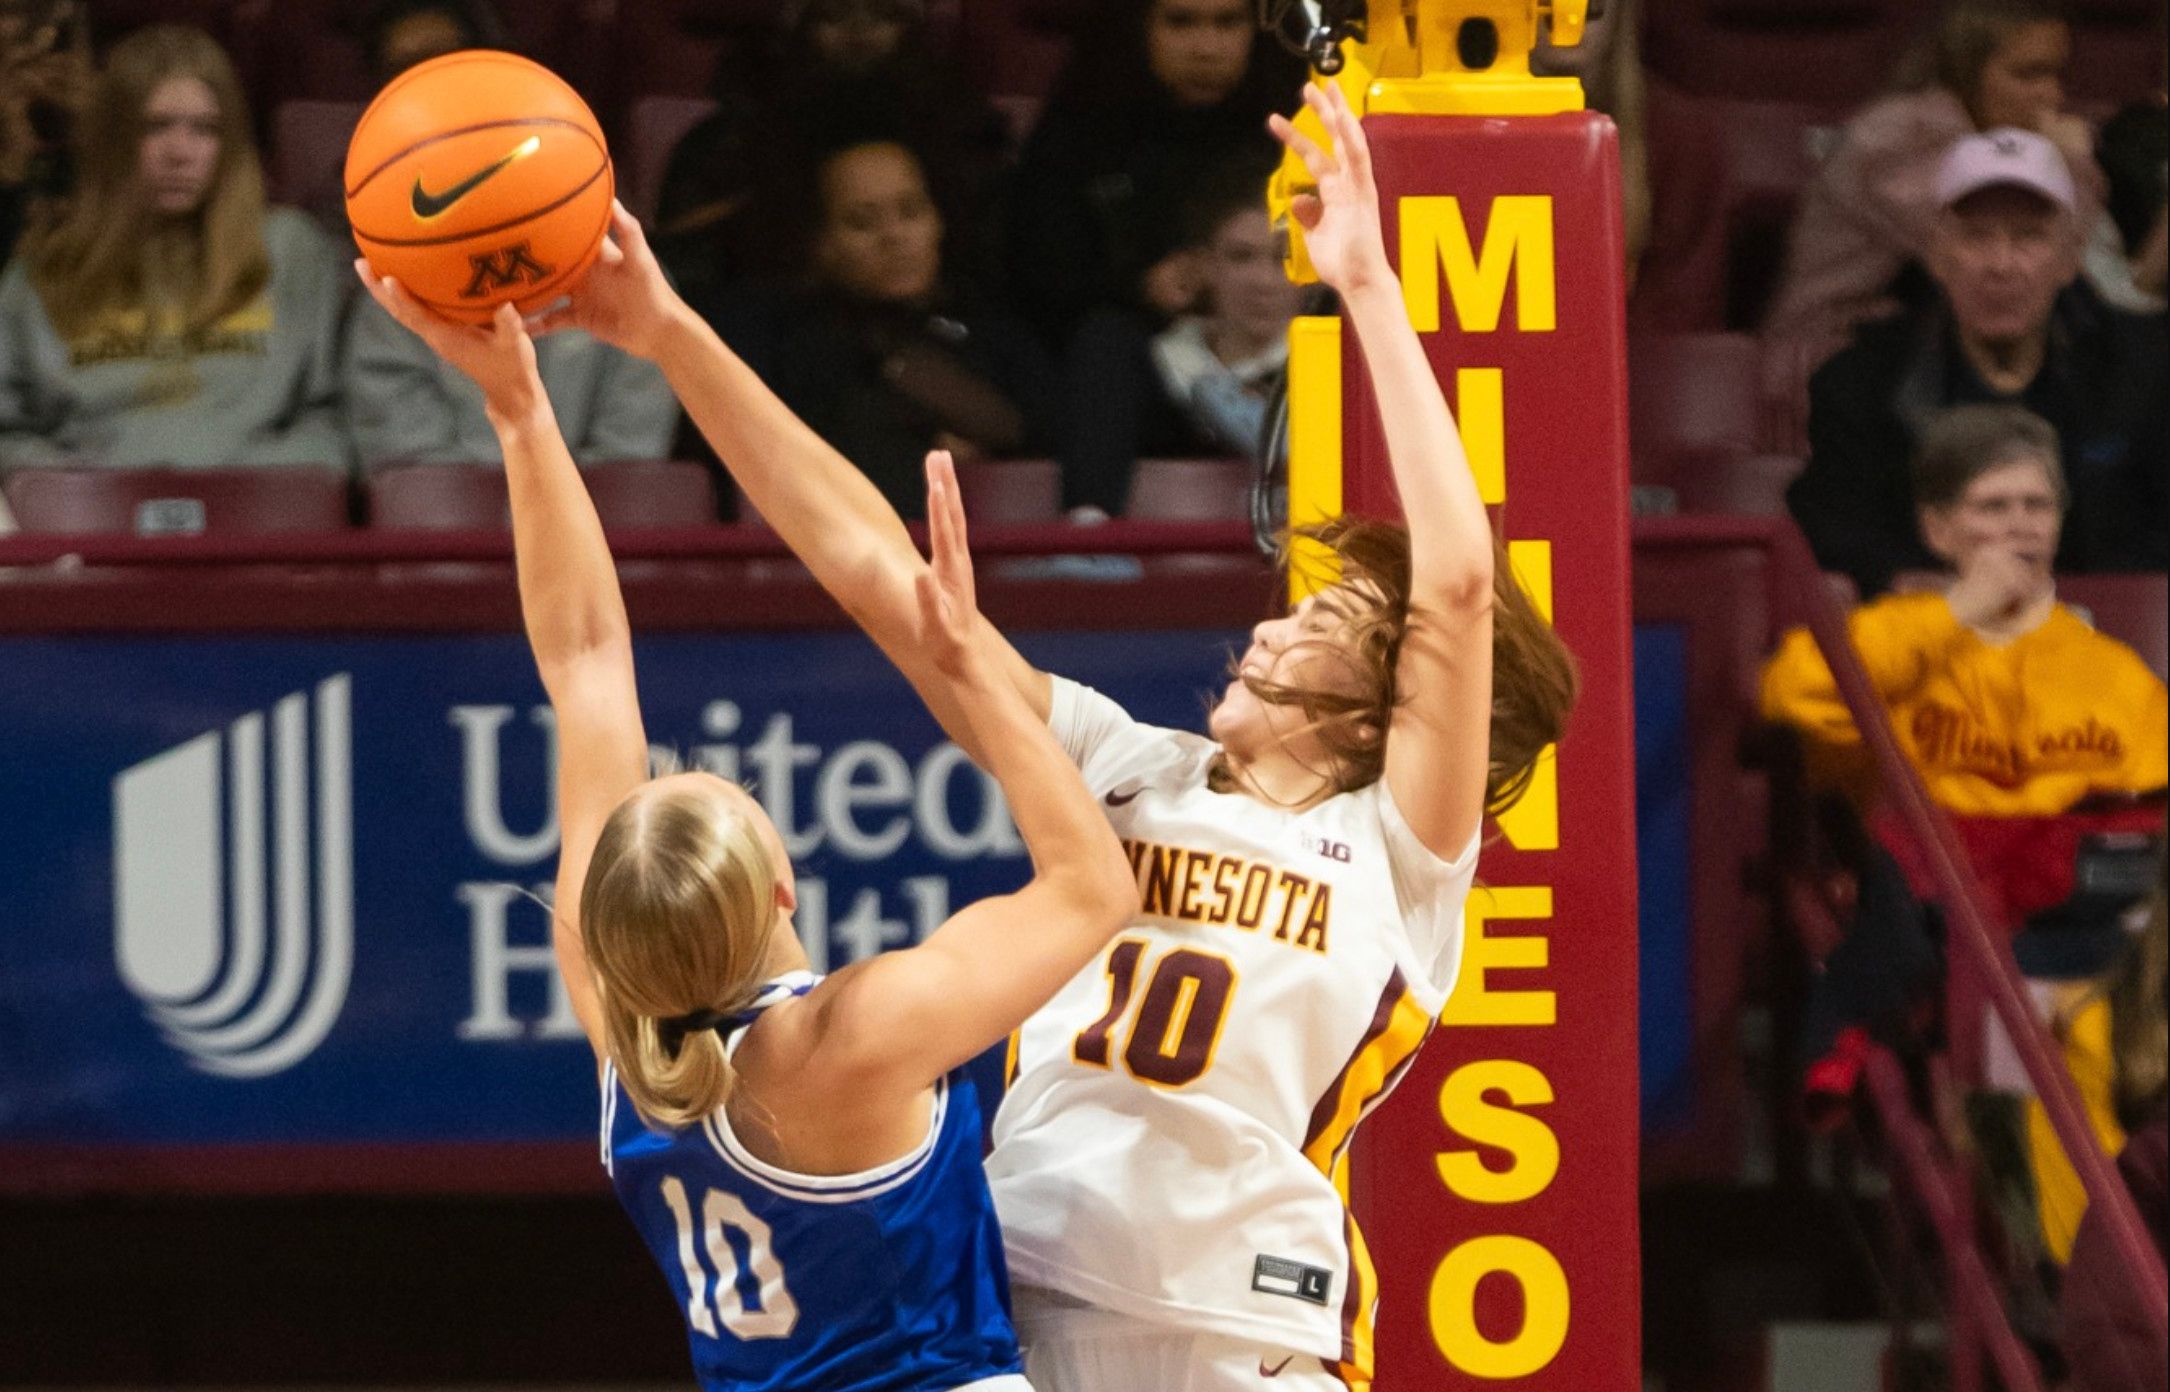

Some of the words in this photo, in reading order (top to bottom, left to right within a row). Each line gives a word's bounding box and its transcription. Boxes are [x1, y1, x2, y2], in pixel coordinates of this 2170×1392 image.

[449, 699, 1029, 865] Uited
[1072, 934, 1241, 1091] 10
[661, 1174, 800, 1342] 10
[1309, 1274, 1320, 1293] L
